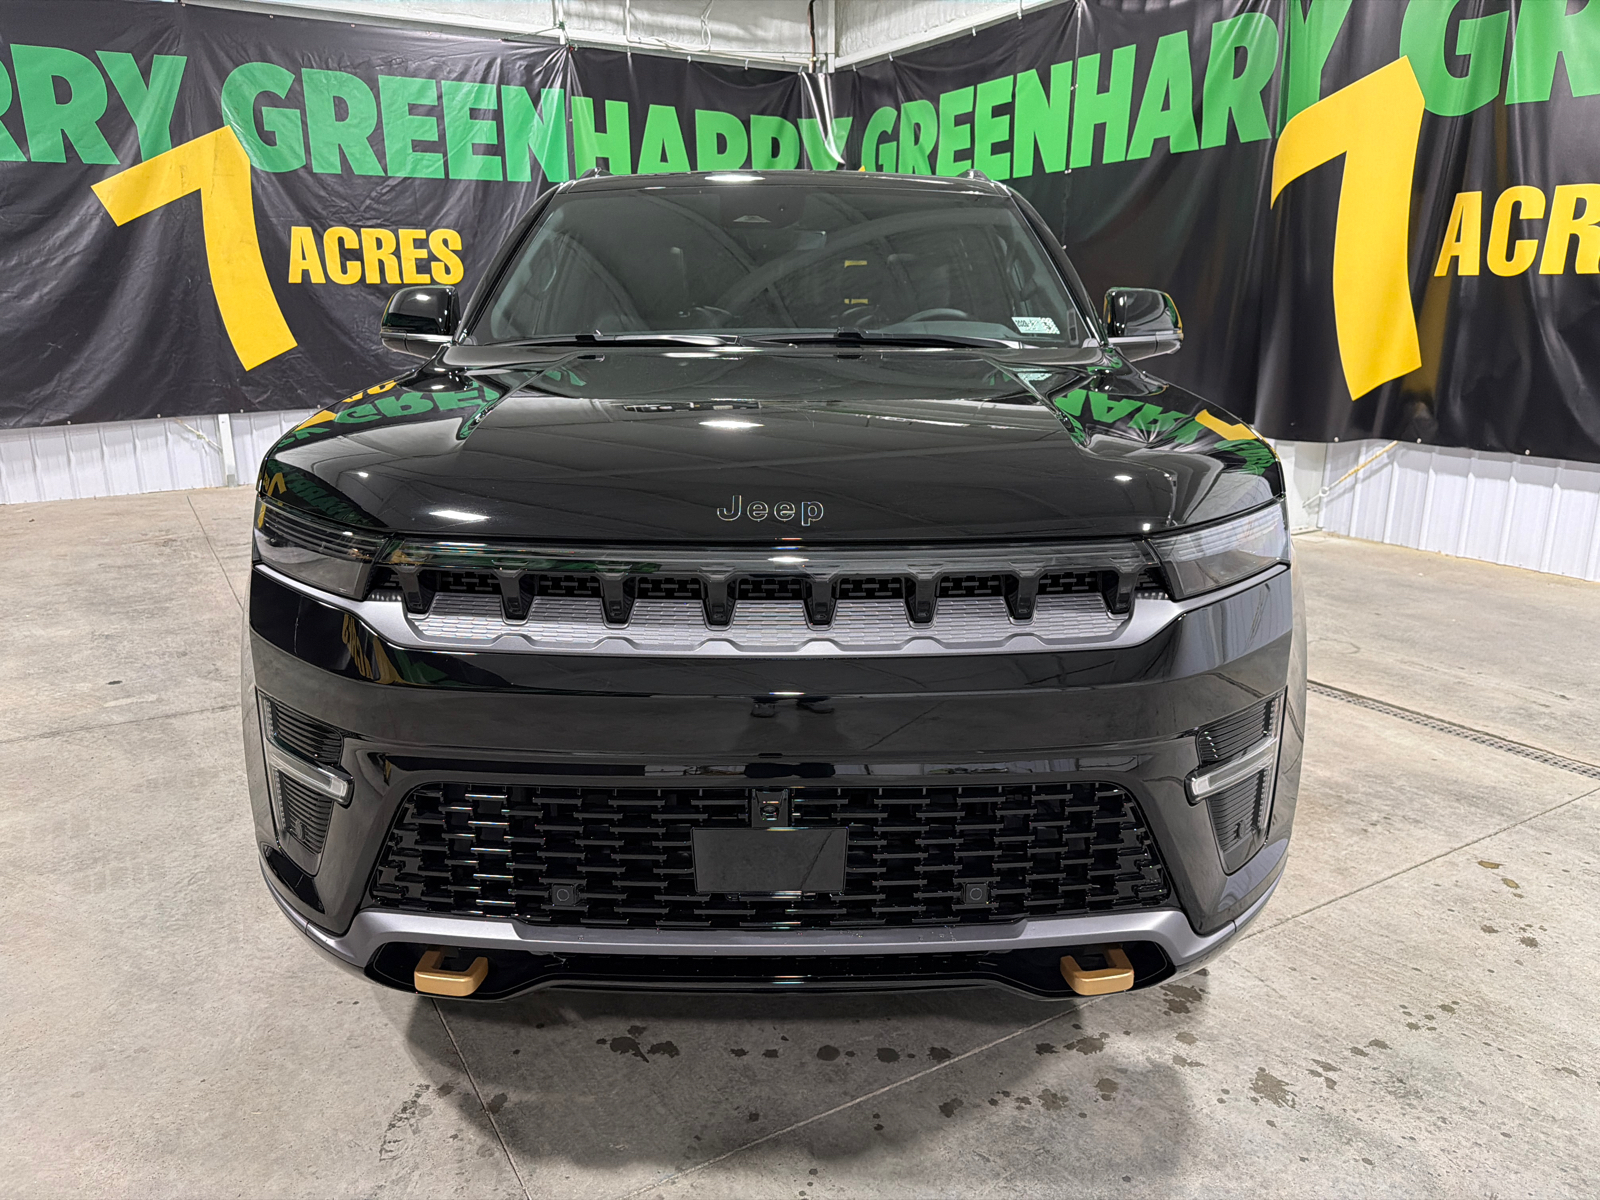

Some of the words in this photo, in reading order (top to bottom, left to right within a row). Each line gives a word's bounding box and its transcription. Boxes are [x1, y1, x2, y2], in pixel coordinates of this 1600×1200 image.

[221, 61, 569, 183] GREEN
[861, 60, 1074, 181] GREEN
[90, 124, 298, 372] 7
[288, 226, 464, 285] ACRES
[1270, 55, 1425, 401] 7
[716, 494, 825, 527] Jeep
